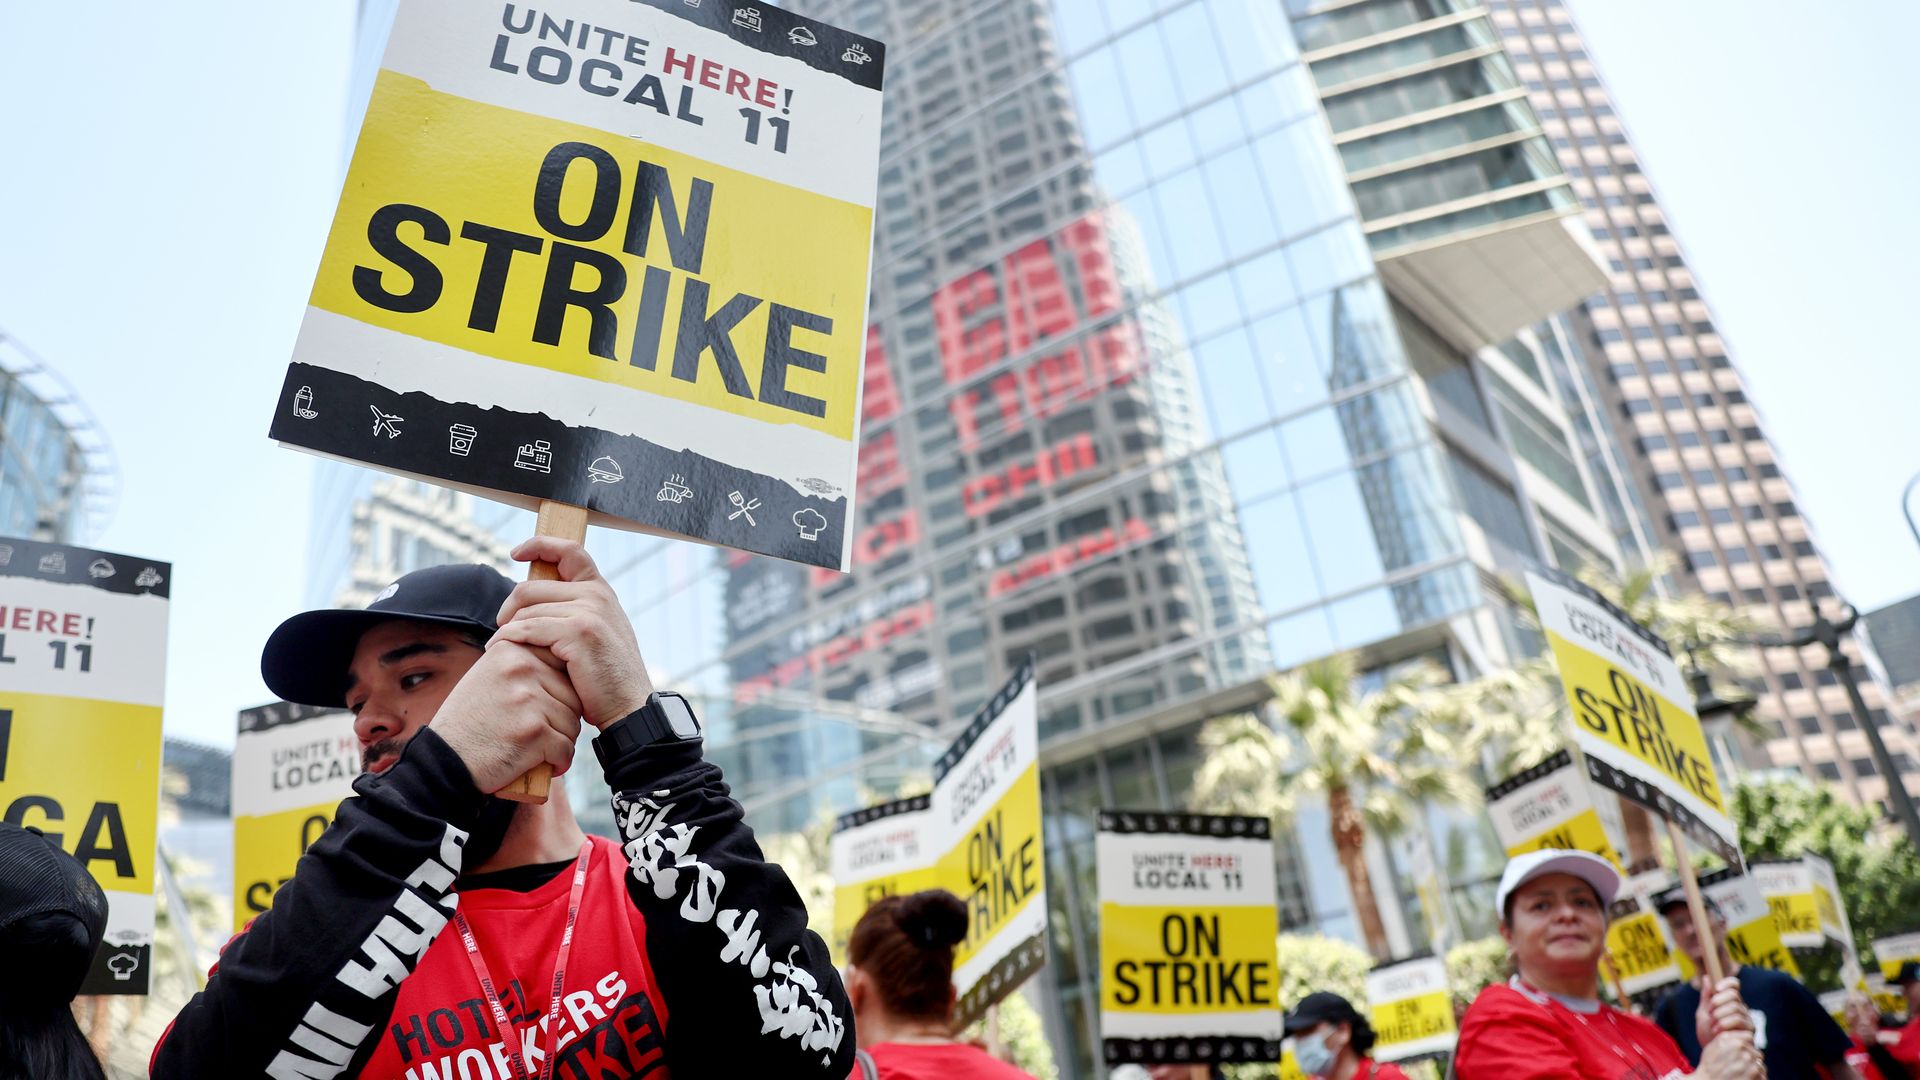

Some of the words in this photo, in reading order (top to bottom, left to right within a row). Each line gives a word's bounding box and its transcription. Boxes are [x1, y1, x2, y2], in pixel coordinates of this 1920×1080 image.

[502, 3, 649, 66] UNITE
[663, 47, 794, 115] HERE!
[490, 34, 704, 126] LOCAL
[739, 107, 790, 154] 11
[533, 141, 714, 275] ON
[352, 203, 834, 419] STRIKE
[0, 605, 95, 638] ERE!
[48, 640, 92, 672] 11
[1609, 669, 1665, 735] ON
[272, 739, 332, 767] UNITE
[272, 757, 358, 791] LOCAL
[1575, 687, 1720, 809] STRIKE
[968, 811, 1003, 885] ON
[1132, 854, 1186, 869] UNITE
[962, 837, 1036, 950] TRIKE
[1134, 871, 1210, 889] LOCAL
[1223, 873, 1243, 889] 11
[1163, 913, 1220, 958] ON
[1618, 921, 1656, 951] ON
[1727, 930, 1750, 962] N
[1114, 961, 1270, 1006] STRIKE
[390, 978, 541, 1064] HOTEL
[404, 970, 627, 1080] WORKERS
